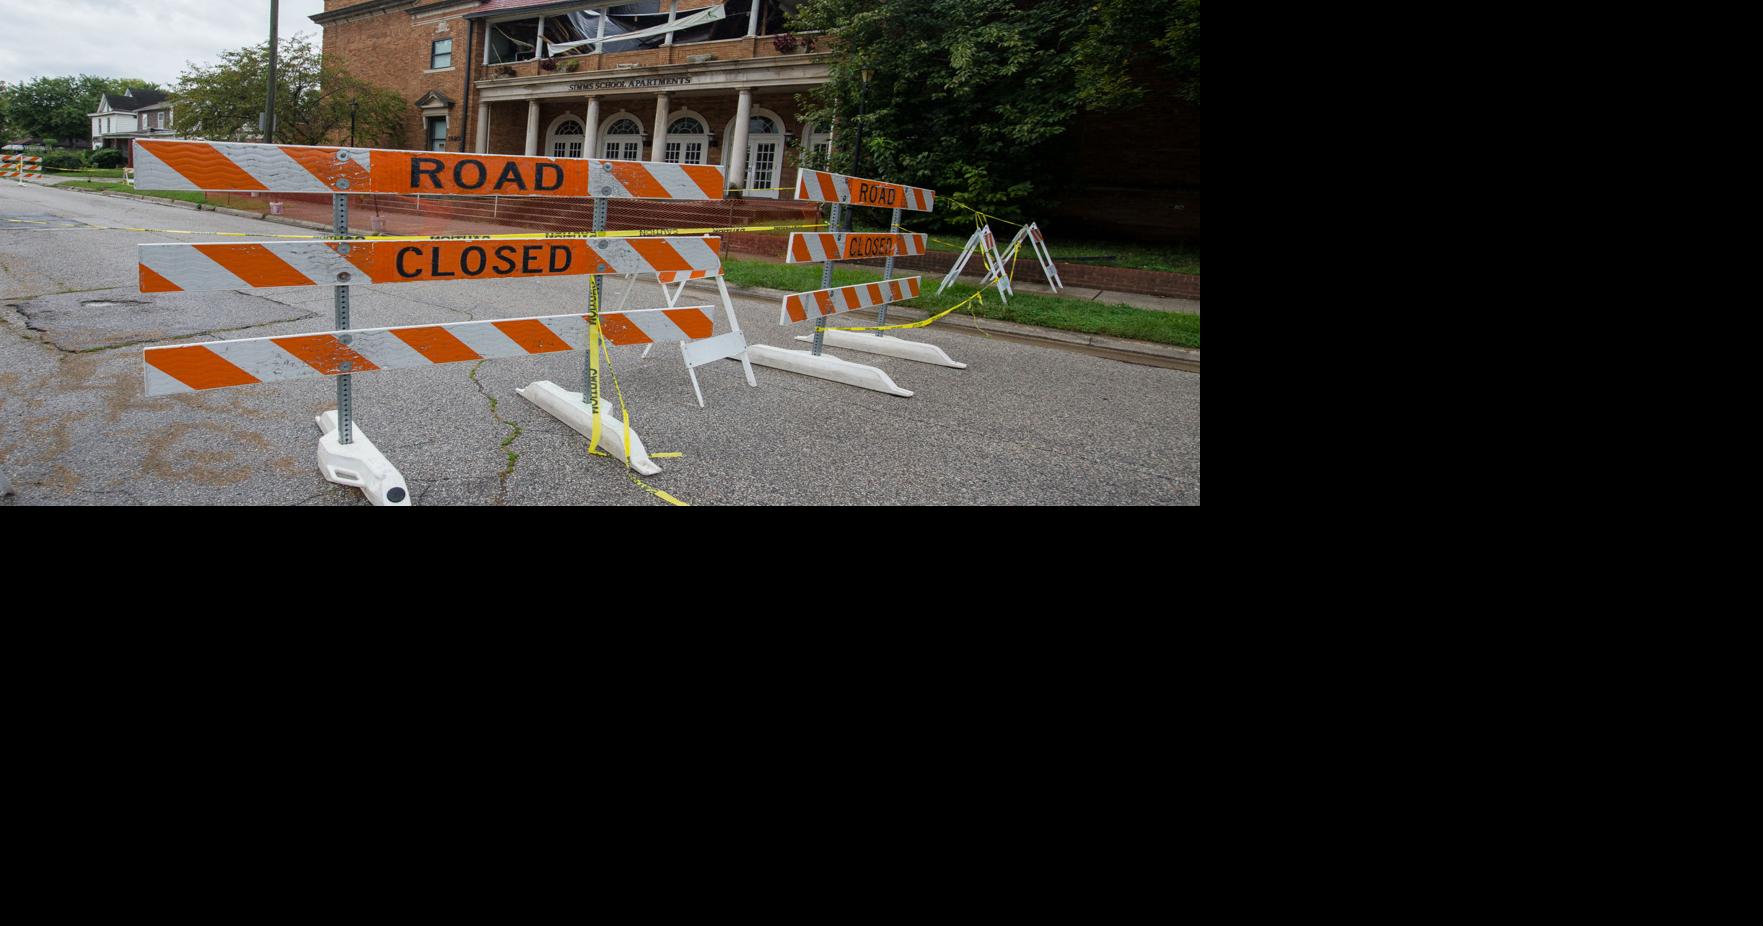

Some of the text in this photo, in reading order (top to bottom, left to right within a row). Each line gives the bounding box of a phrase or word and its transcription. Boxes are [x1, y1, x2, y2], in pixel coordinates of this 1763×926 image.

[569, 76, 691, 91] SIMMS SCHOOL APARTMENTS
[410, 157, 564, 191] ROAD
[859, 183, 896, 205] ROAD
[849, 237, 892, 257] CLOSED
[396, 245, 572, 278] CLOSED
